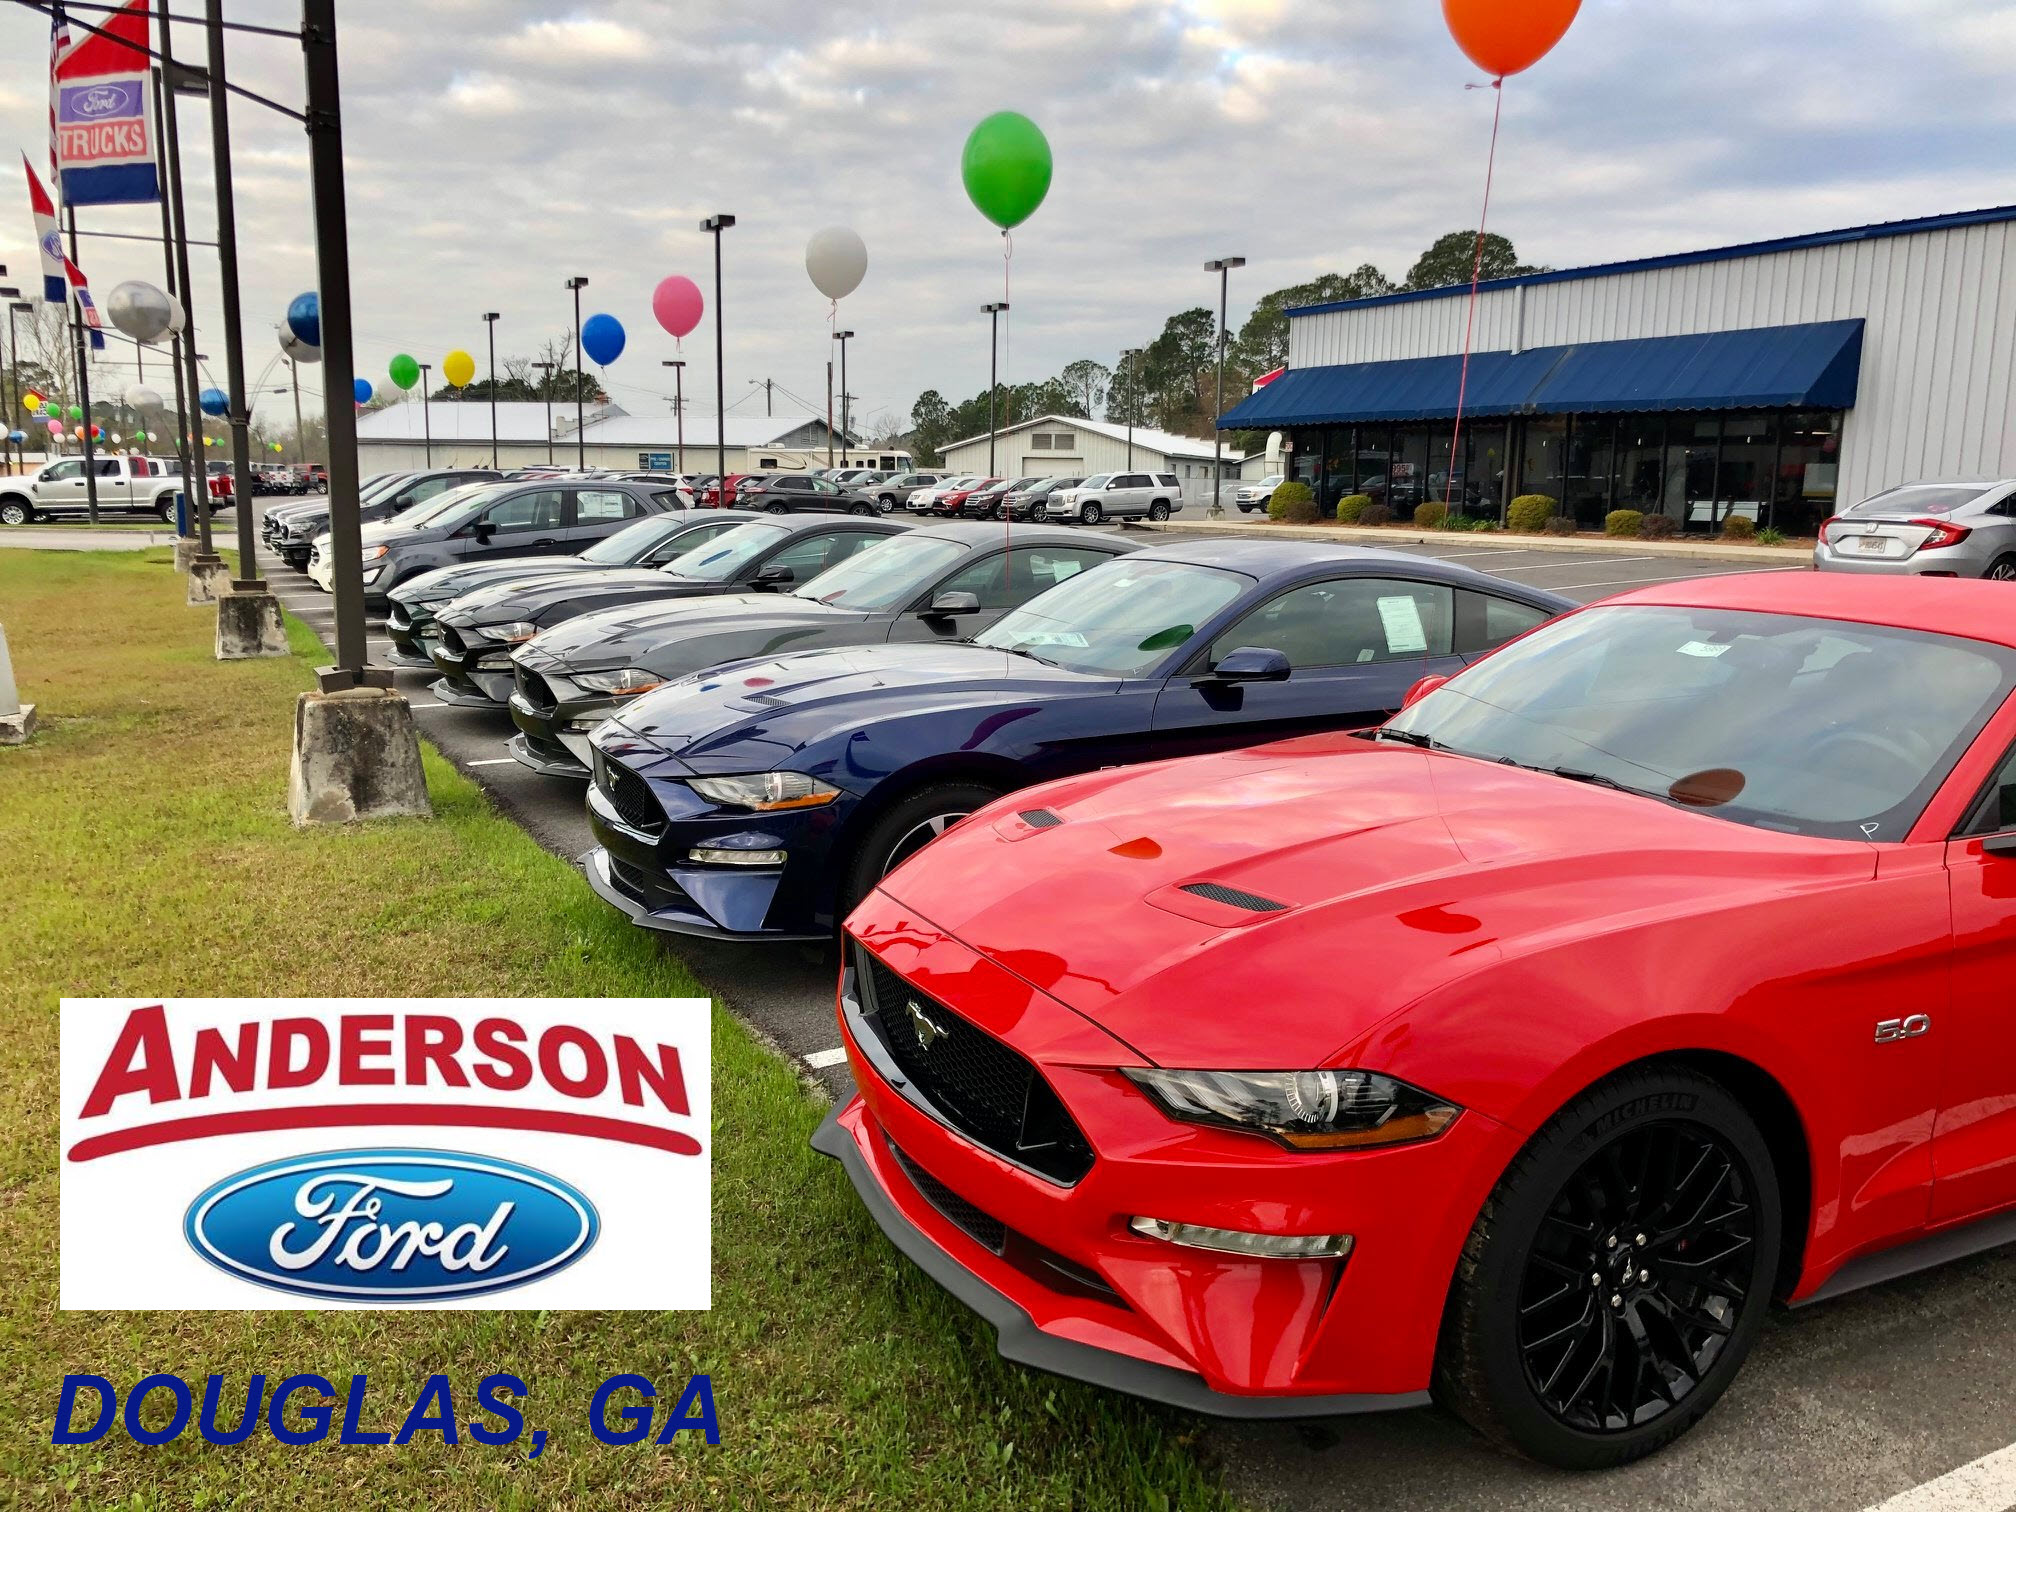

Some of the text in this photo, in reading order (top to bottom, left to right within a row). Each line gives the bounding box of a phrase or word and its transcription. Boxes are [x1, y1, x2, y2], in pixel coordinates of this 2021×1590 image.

[83, 90, 116, 112] Ford
[60, 124, 144, 156] TRUCKS
[1875, 1014, 1931, 1043] 5.0
[1596, 1093, 1694, 1137] MICHELIN
